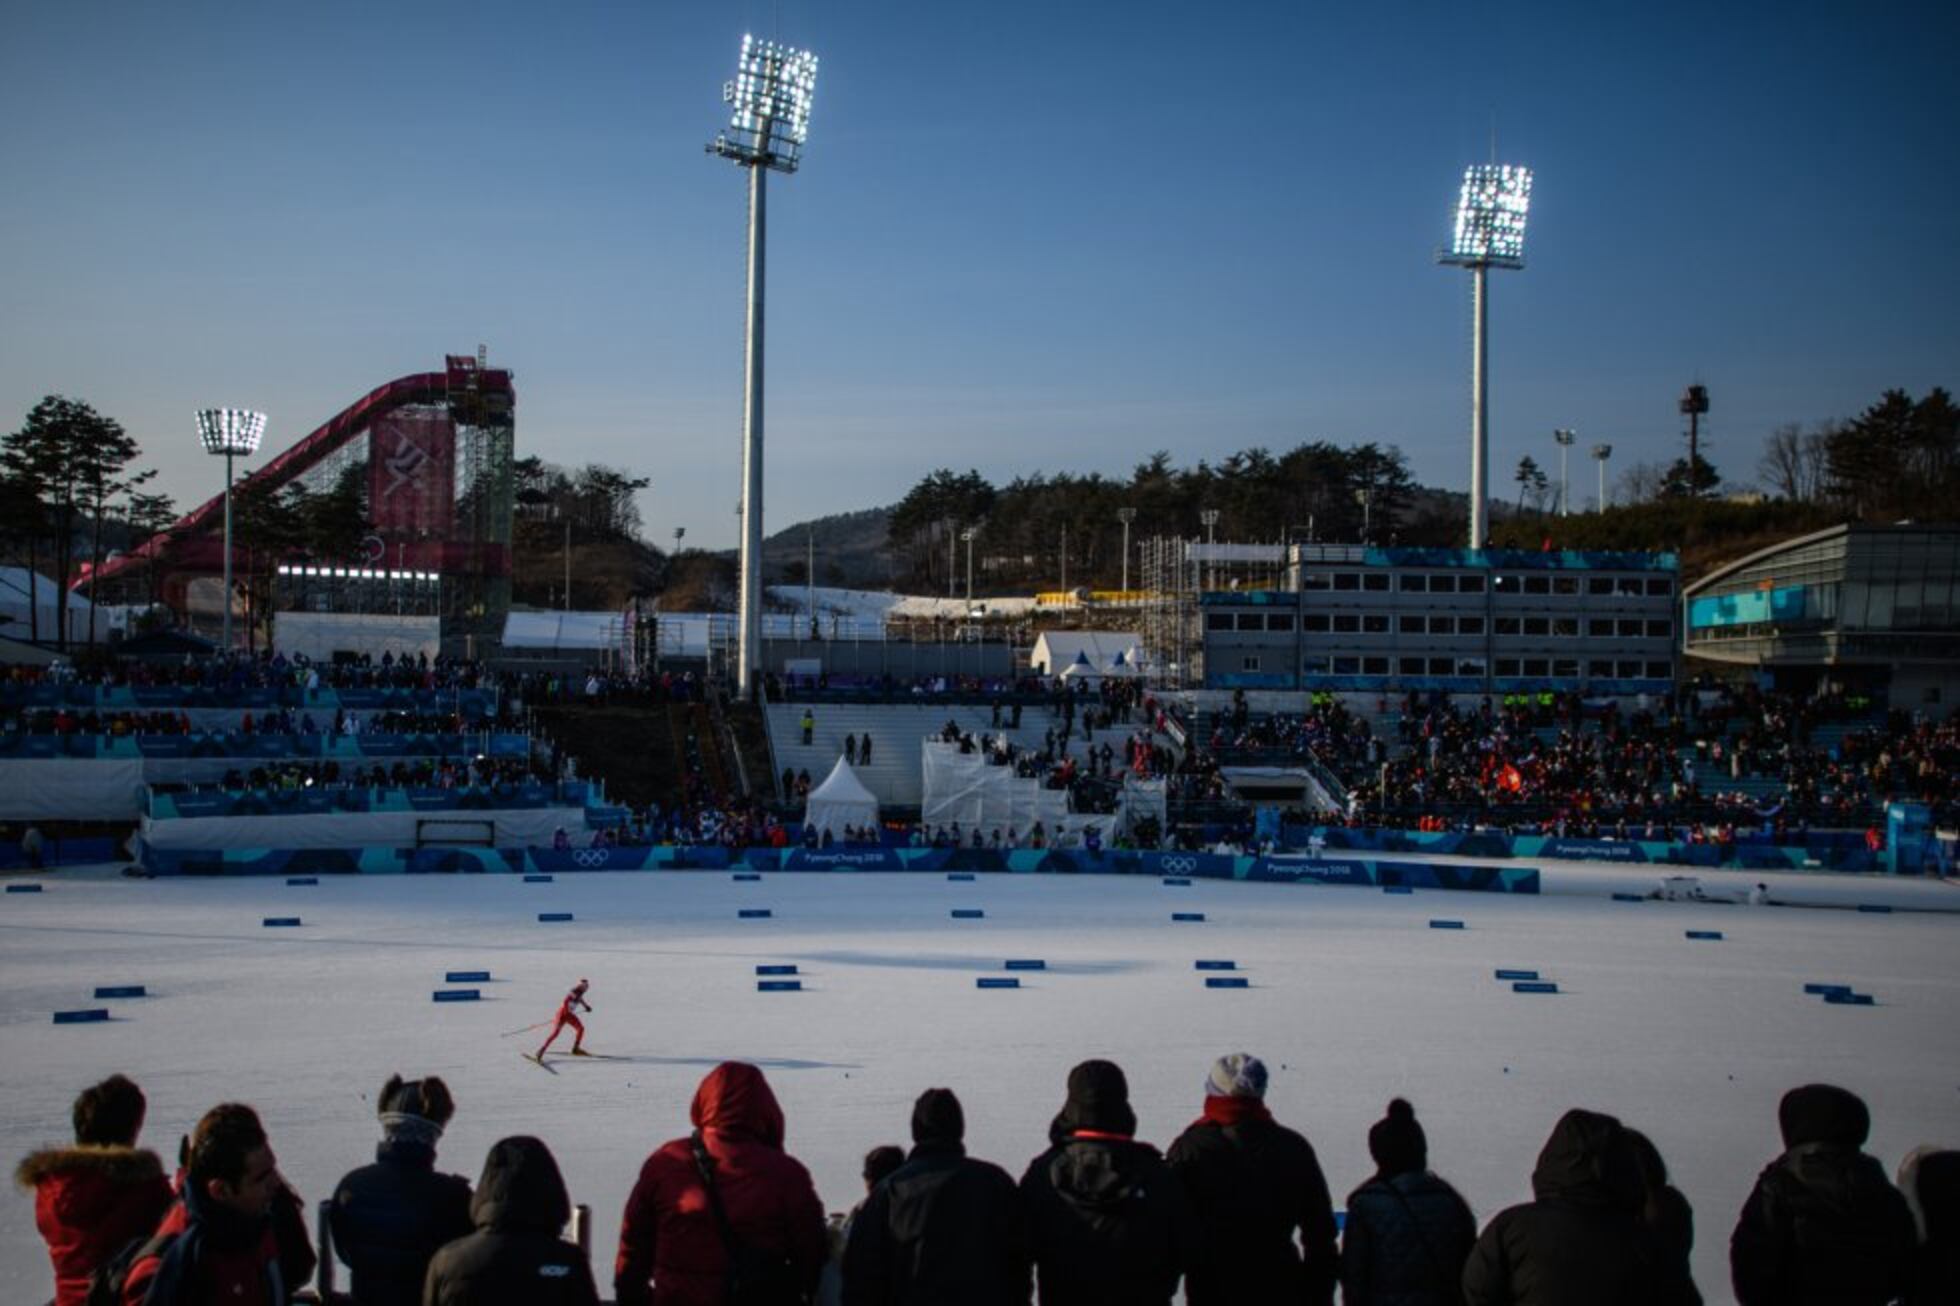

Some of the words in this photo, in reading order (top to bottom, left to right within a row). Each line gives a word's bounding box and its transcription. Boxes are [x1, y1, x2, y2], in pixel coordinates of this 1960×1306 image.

[804, 853, 862, 864] PyeongChang
[1267, 863, 1328, 875] PyeongChang
[1329, 865, 1351, 875] 2018
